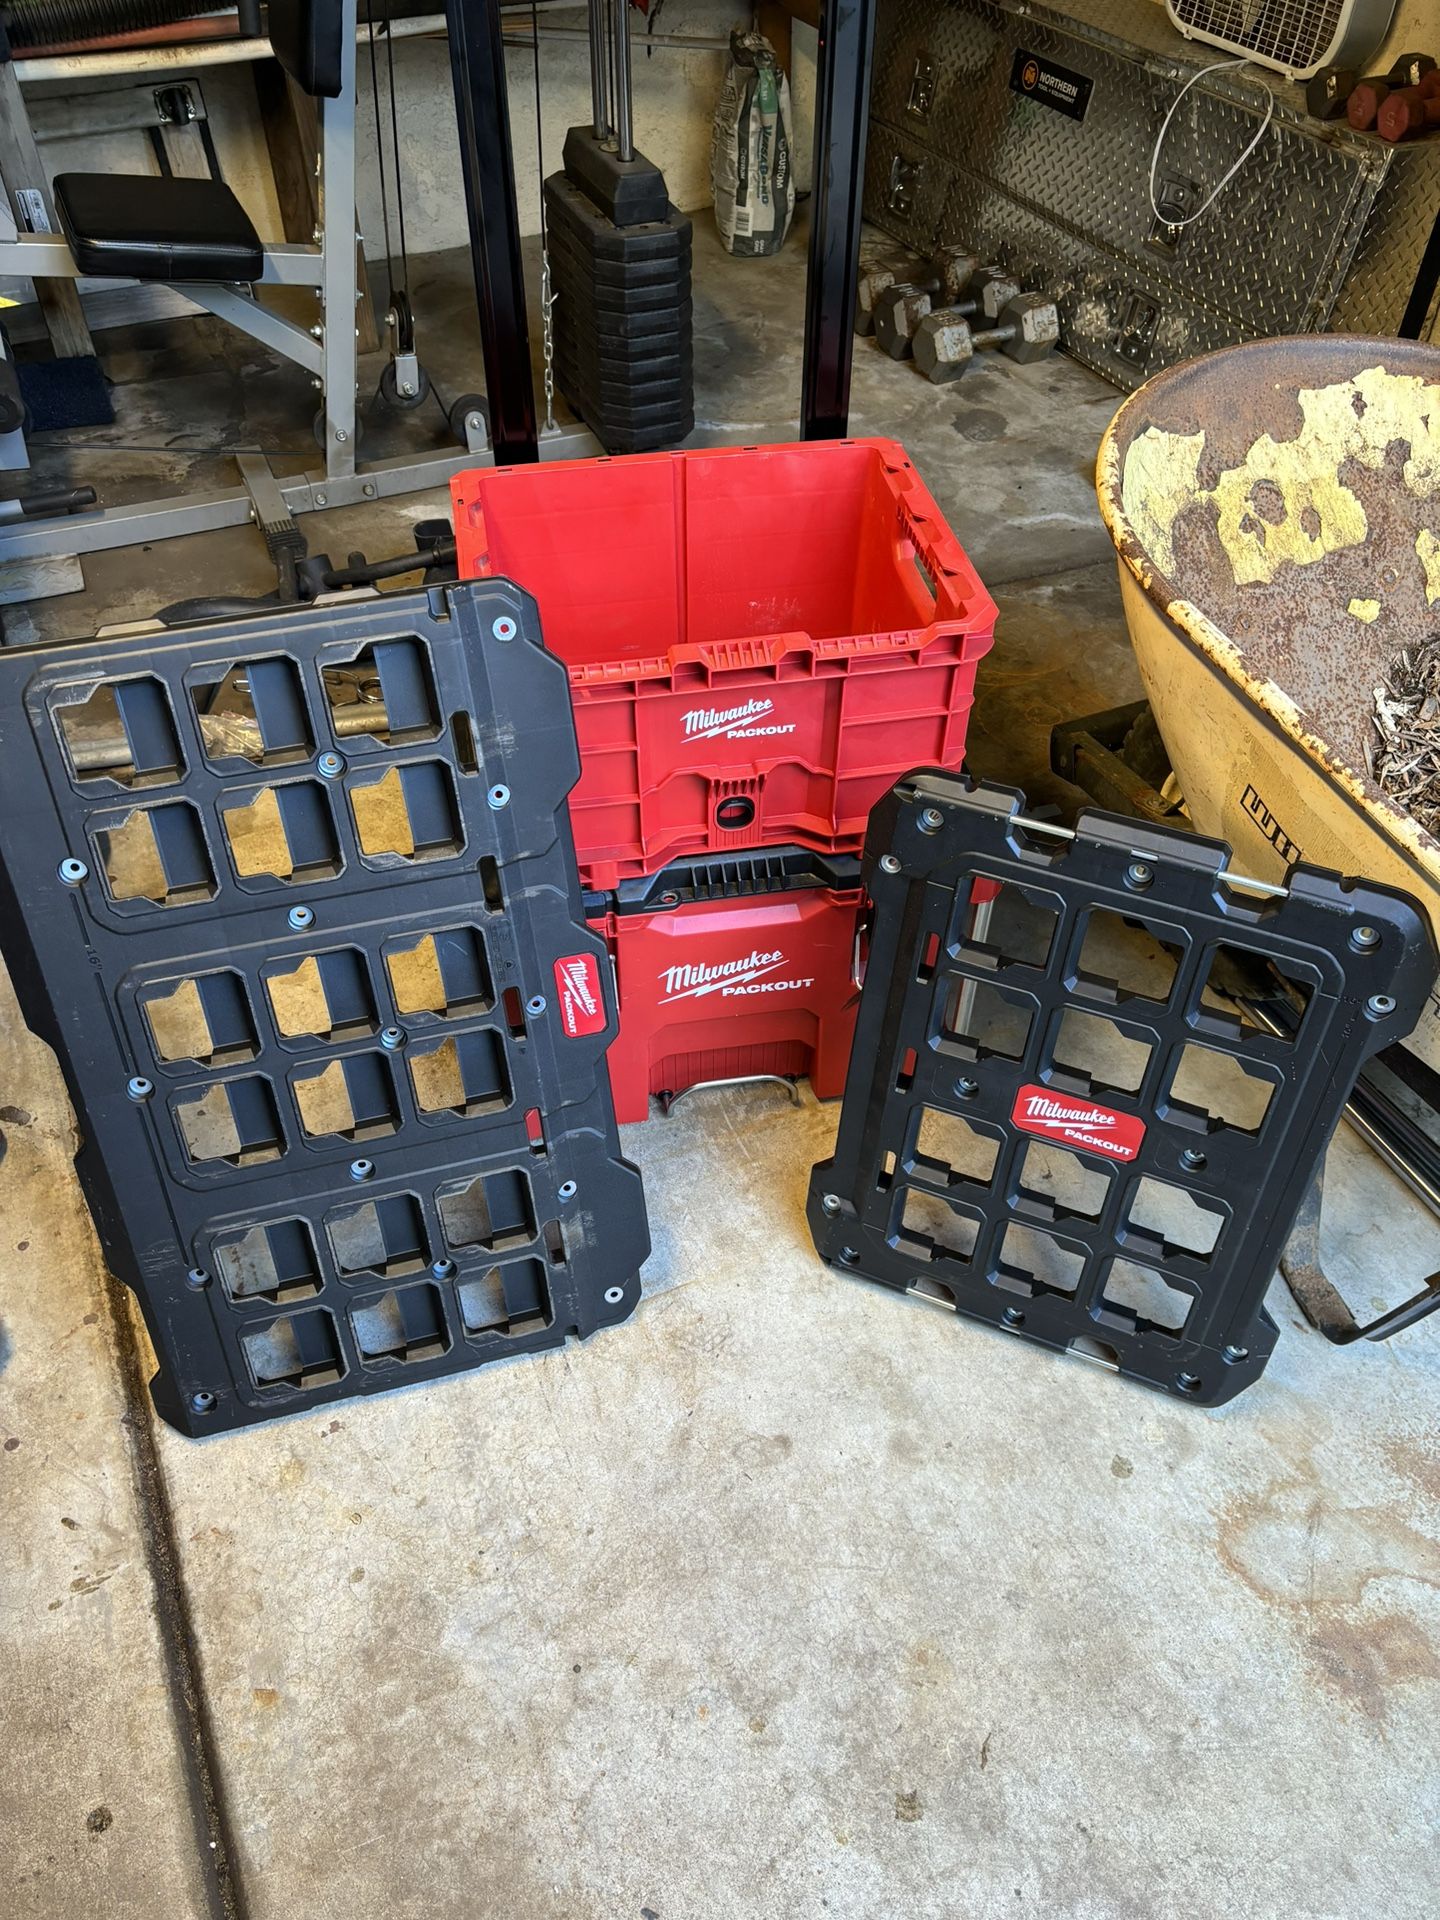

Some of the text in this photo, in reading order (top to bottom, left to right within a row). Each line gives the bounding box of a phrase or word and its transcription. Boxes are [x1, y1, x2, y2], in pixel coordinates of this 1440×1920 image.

[1040, 71, 1079, 97] NORTHERN
[776, 150, 787, 189] CUSTOM
[680, 699, 774, 735] Milwaukee
[727, 724, 796, 739] PACKOUT
[566, 958, 598, 1016] Milwaukee
[657, 950, 783, 994] Milwaukee
[722, 978, 815, 997] PACKOUT
[563, 990, 577, 1034] PACKOUT
[1024, 1095, 1116, 1125] Milwaukee
[1064, 1128, 1133, 1156] PACKOUT
